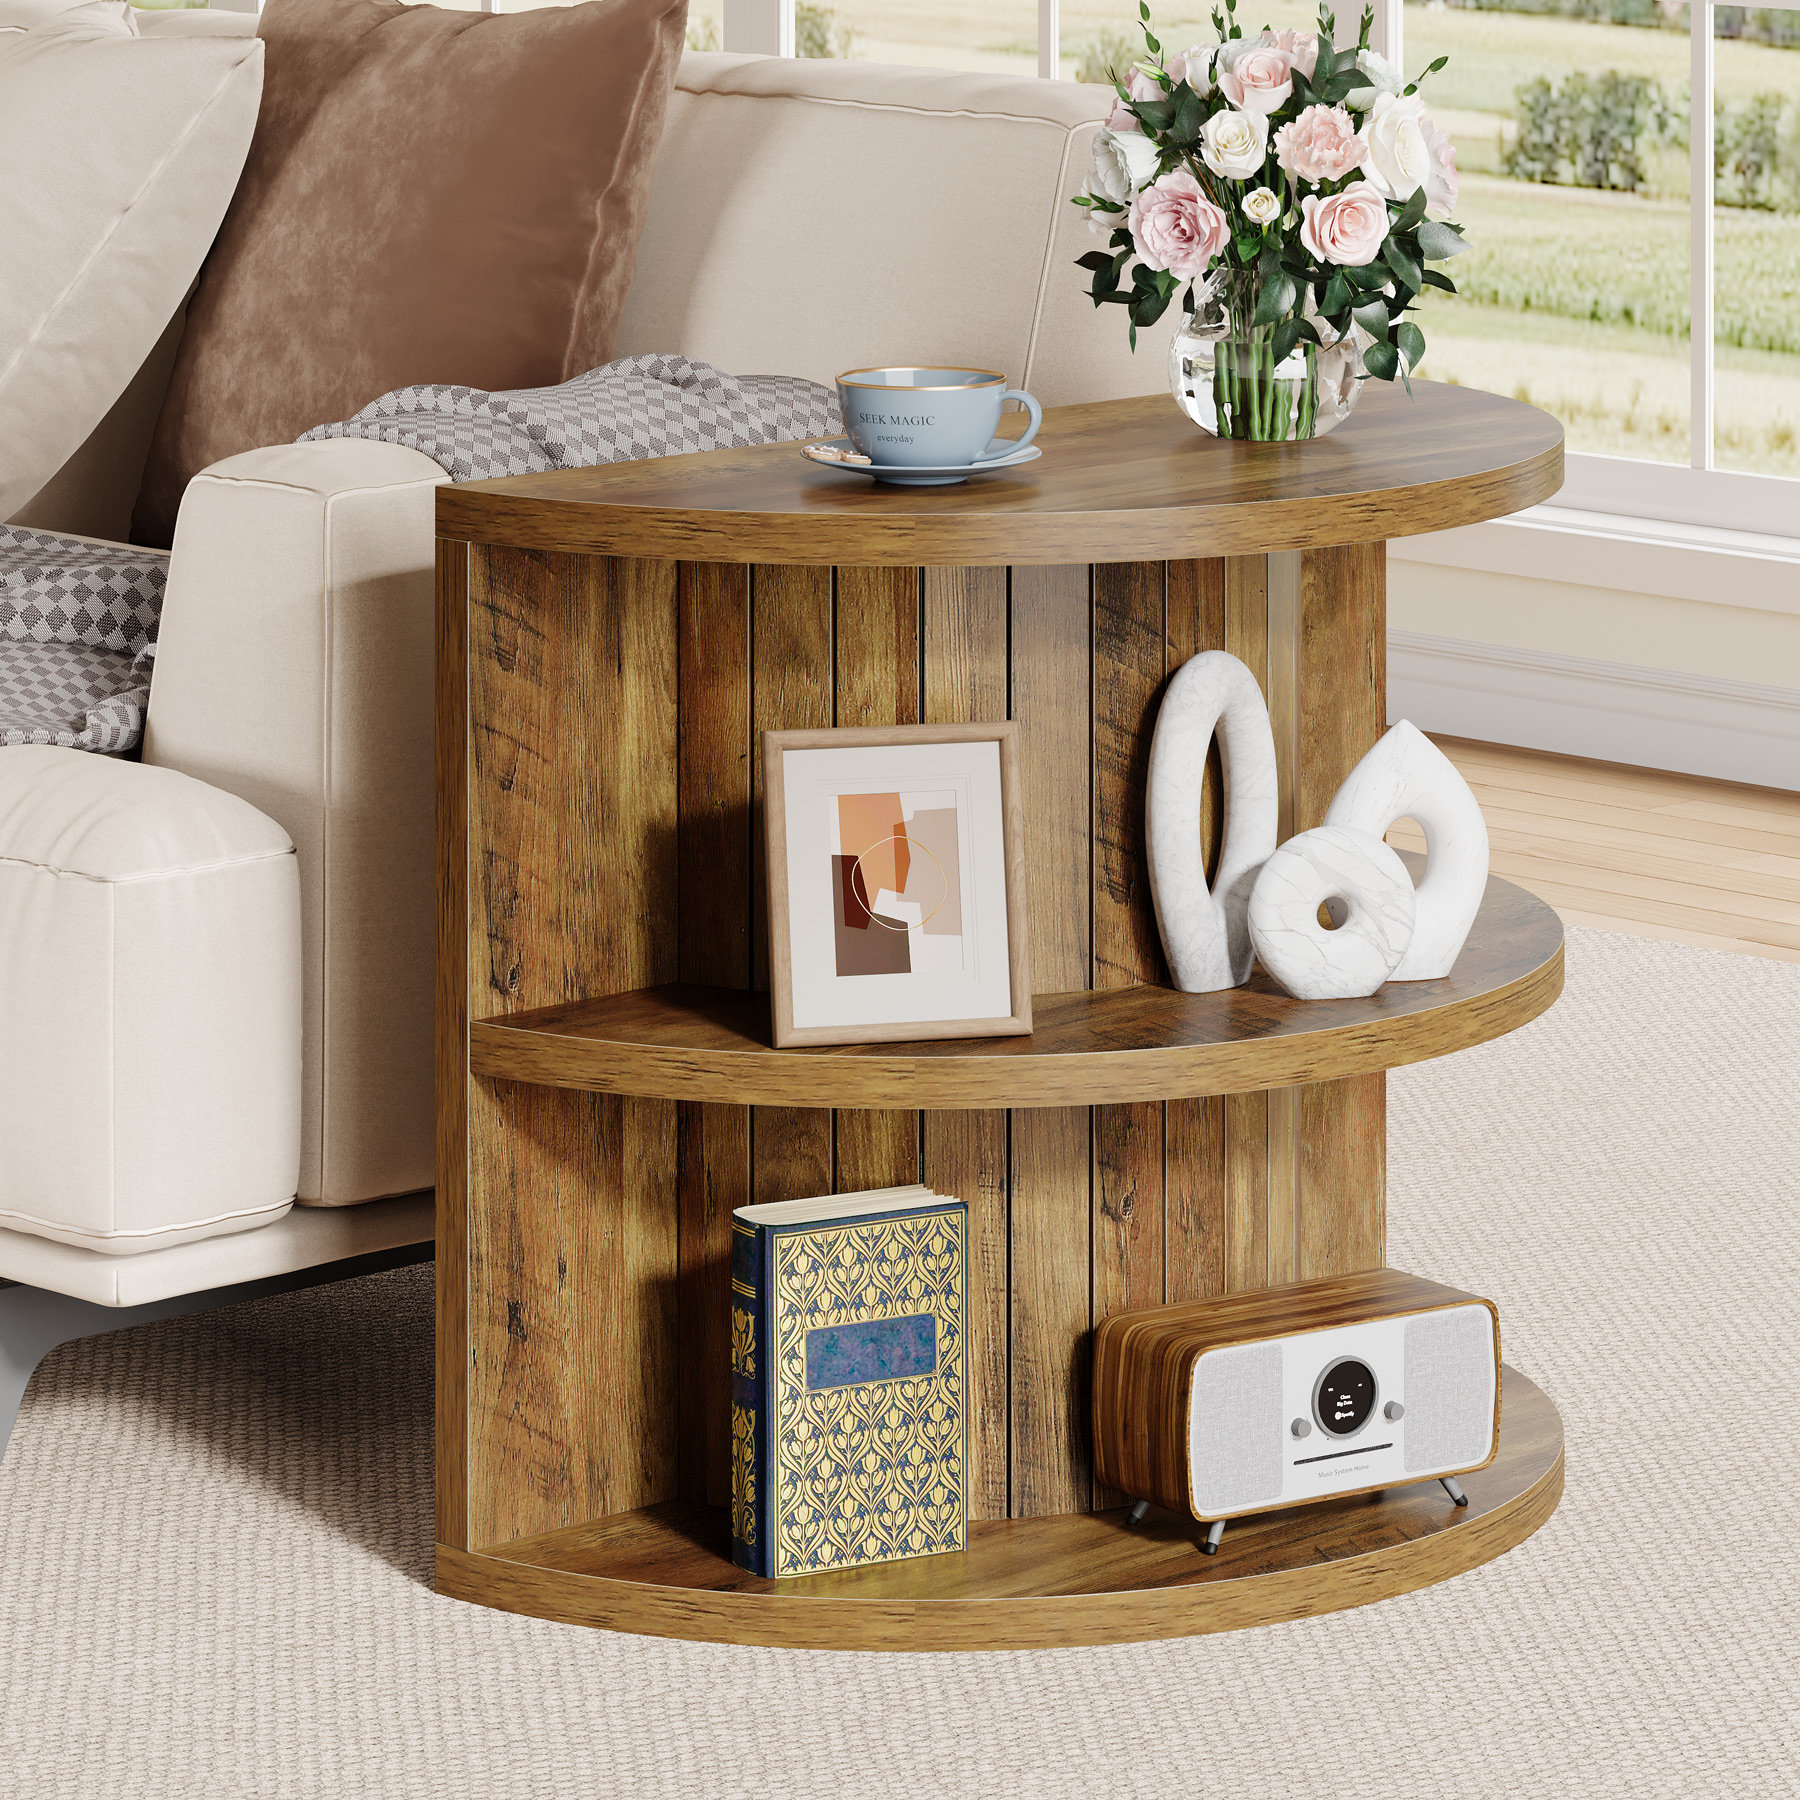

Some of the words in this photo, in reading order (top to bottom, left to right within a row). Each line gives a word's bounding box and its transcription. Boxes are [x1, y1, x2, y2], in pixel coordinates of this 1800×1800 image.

[859, 412, 886, 425] SEEK
[890, 415, 936, 426] MAGIC
[877, 434, 914, 444] everyday
[1334, 1468, 1353, 1476] System
